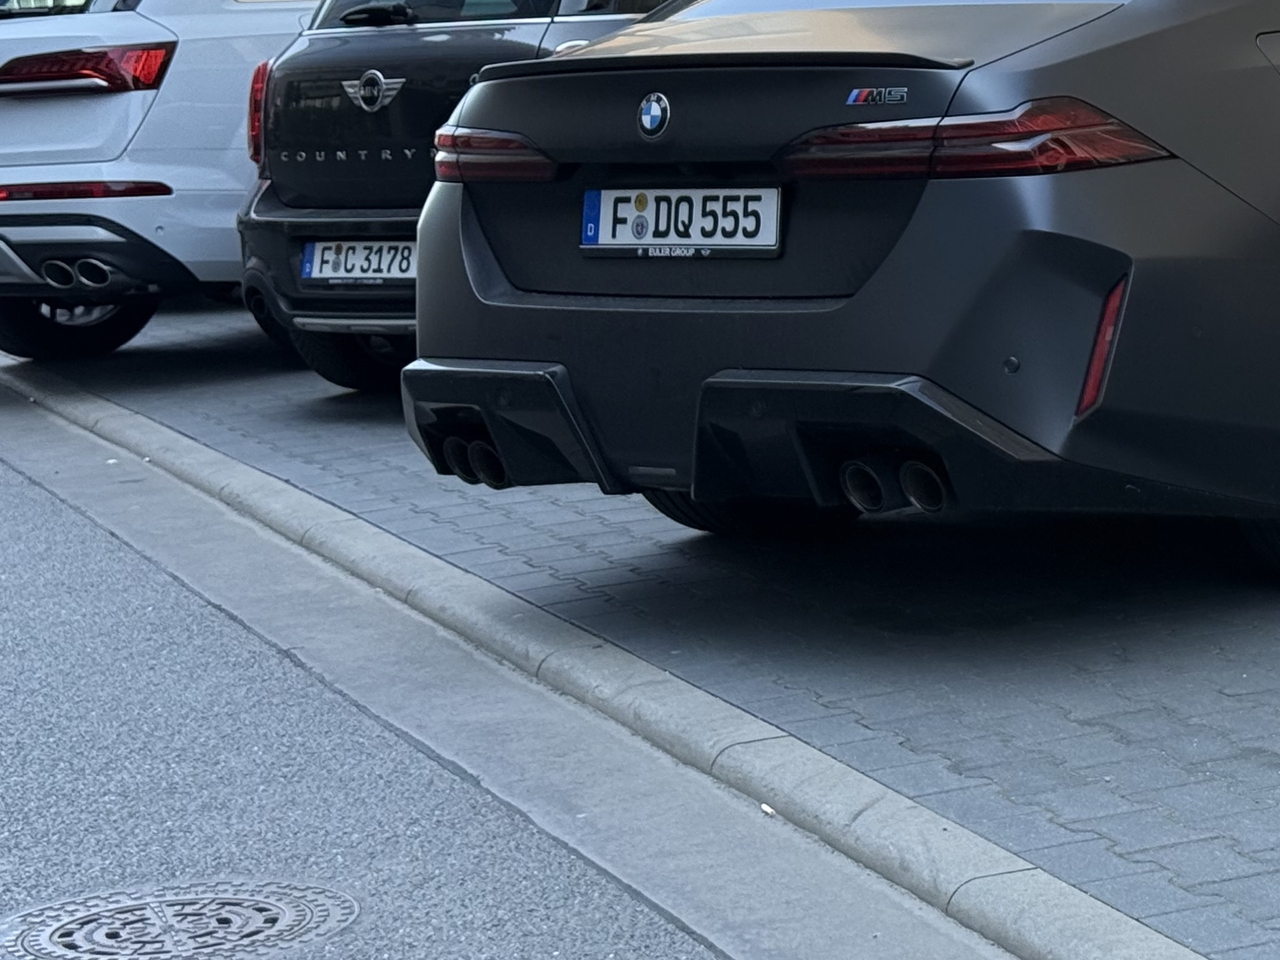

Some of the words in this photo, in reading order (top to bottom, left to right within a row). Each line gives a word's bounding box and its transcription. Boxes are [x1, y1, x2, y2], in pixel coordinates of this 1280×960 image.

[862, 86, 908, 105] M5
[611, 196, 632, 239] F
[652, 195, 694, 239] DQ
[700, 195, 762, 239] 555
[319, 245, 333, 274] F
[344, 245, 356, 273] C
[360, 245, 412, 273] 3178
[648, 247, 671, 257] EULER
[671, 247, 695, 257] GROUP
